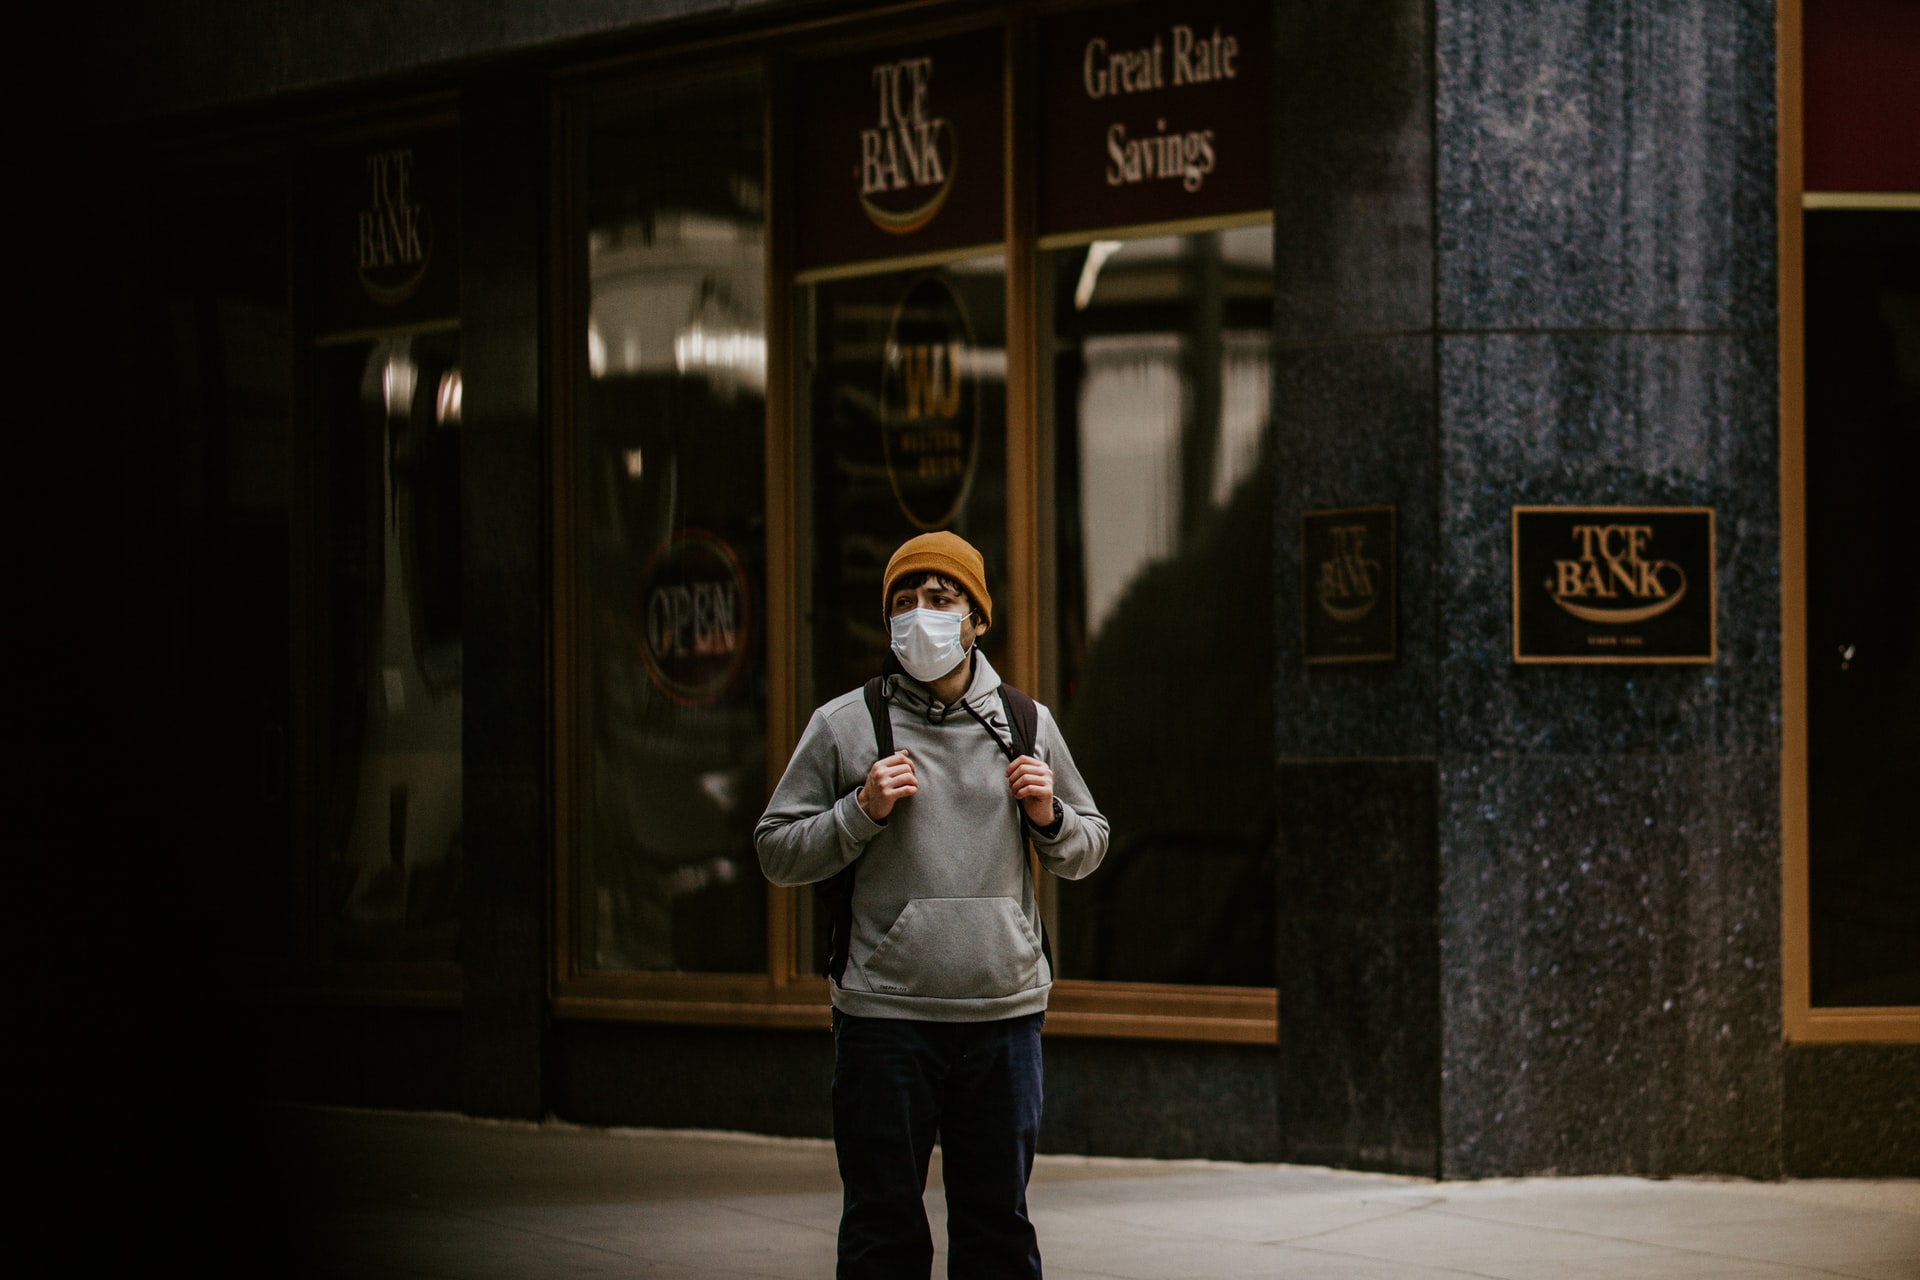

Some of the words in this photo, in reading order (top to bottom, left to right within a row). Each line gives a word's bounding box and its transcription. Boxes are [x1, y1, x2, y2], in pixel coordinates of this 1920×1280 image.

[1083, 35, 1166, 99] Great
[1171, 23, 1239, 87] Rate
[859, 116, 947, 196] BANK
[1105, 118, 1217, 193] Savings
[358, 203, 424, 269] BANK
[1553, 559, 1668, 599] BANK
[1571, 524, 1655, 562] TCF
[648, 580, 737, 660] OPEN
